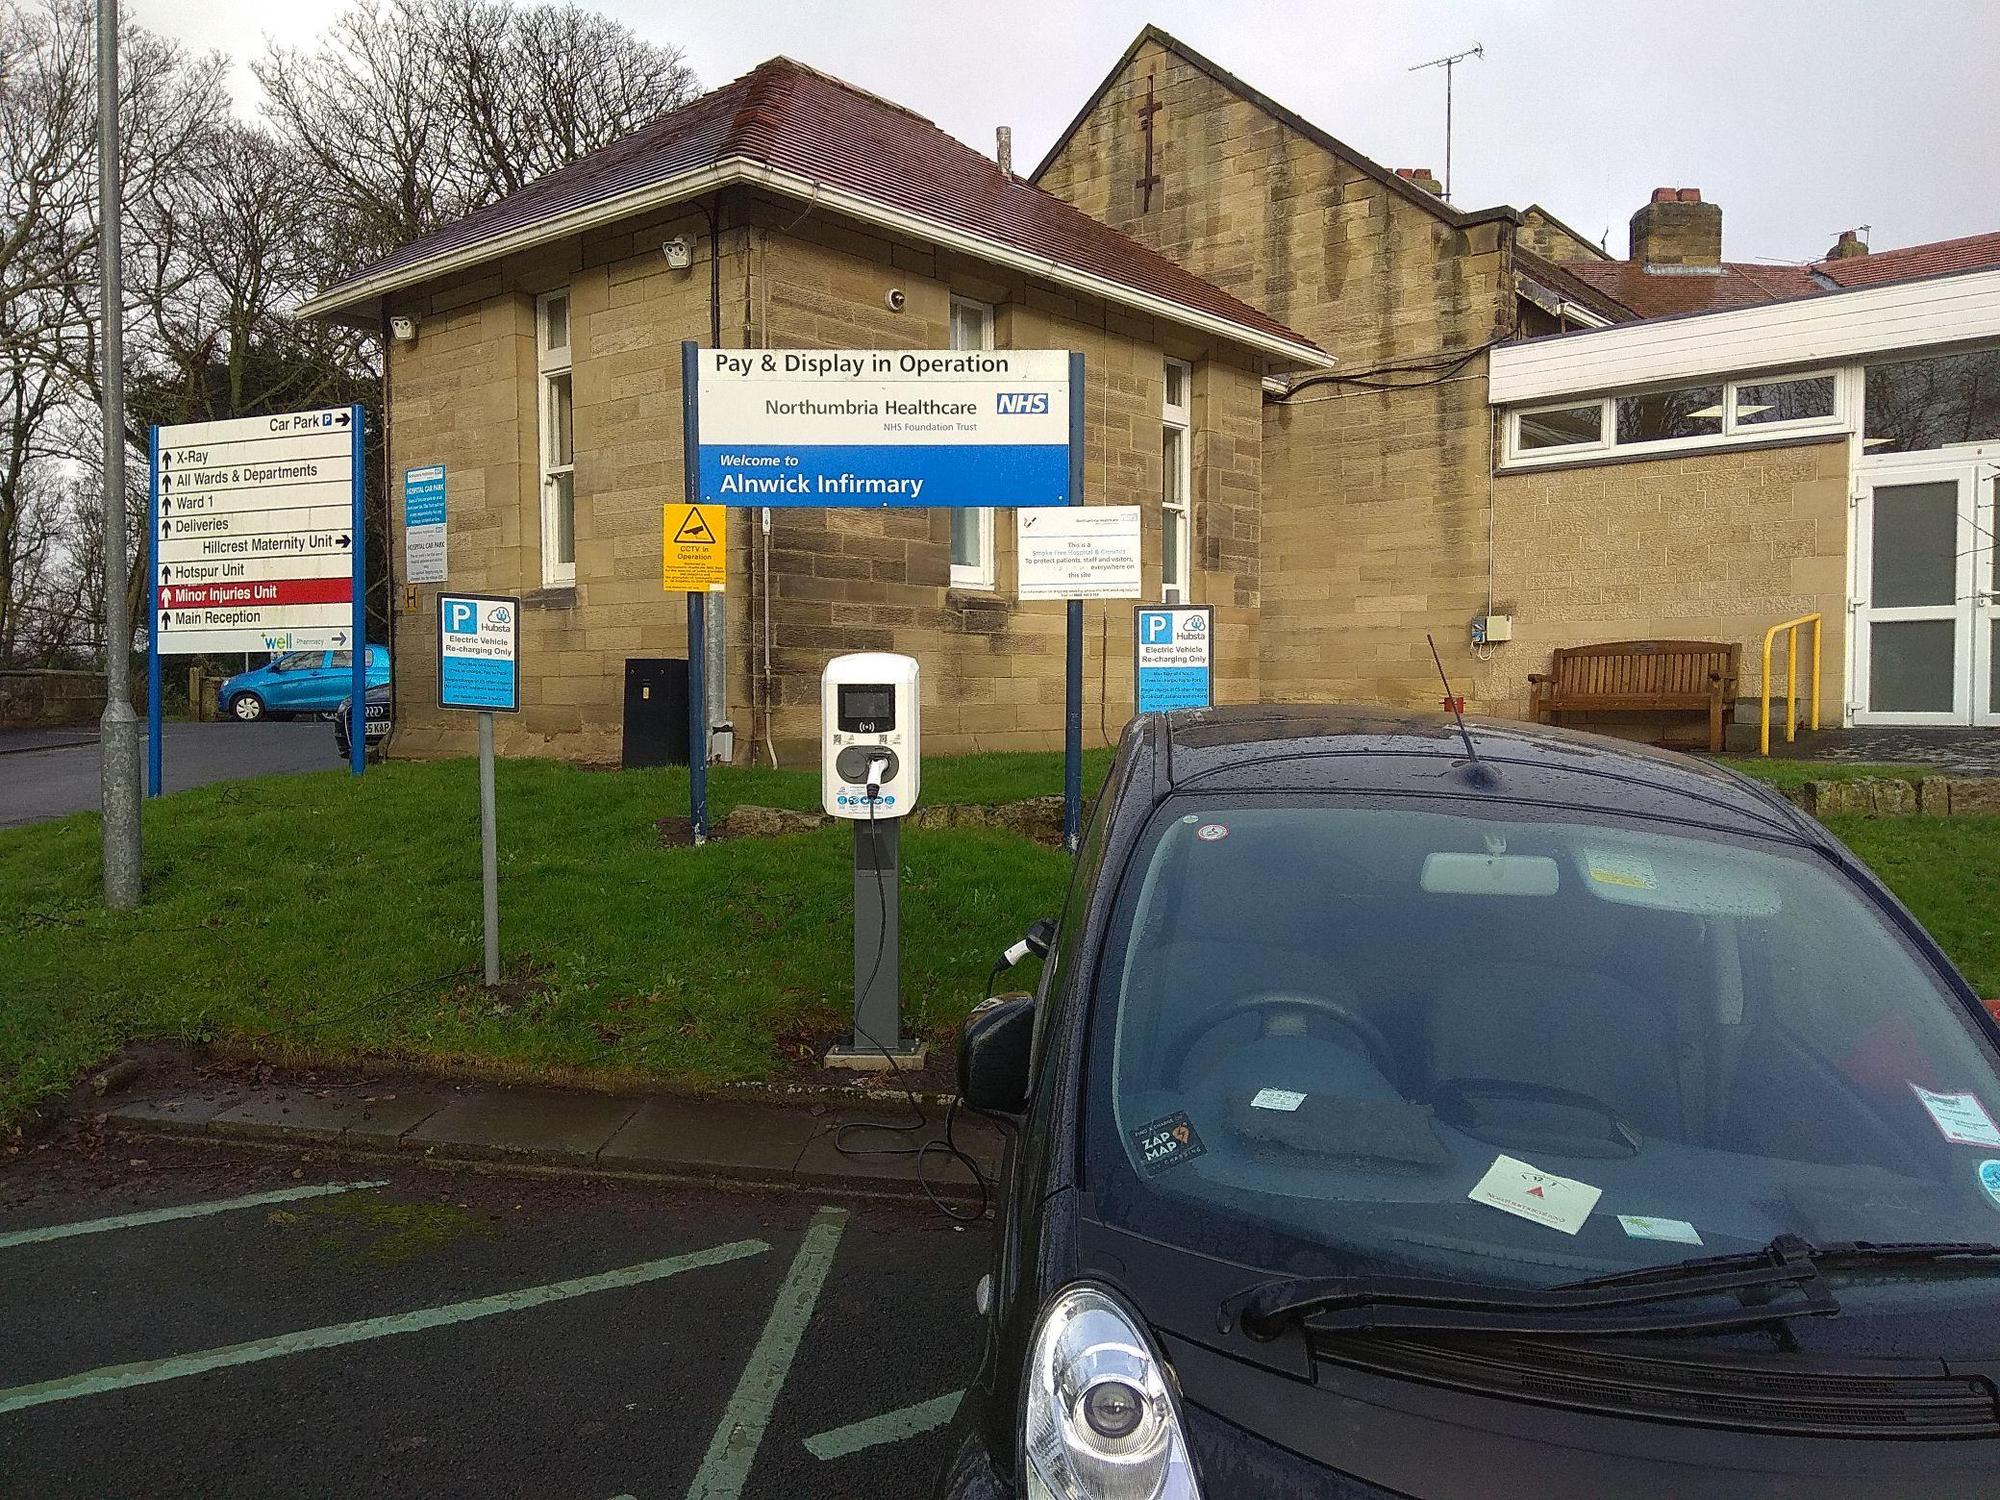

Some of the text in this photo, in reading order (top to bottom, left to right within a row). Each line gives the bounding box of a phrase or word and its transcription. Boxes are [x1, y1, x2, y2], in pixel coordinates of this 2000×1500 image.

[715, 353, 1009, 377] Pay & Display in Operation
[765, 399, 978, 415] Northumbria Healthcare
[997, 393, 1048, 414] NHS
[269, 418, 290, 431] Car
[294, 415, 320, 429] Park
[883, 422, 978, 431] NHS Foundation Trust
[177, 450, 209, 465] X-Ray
[719, 454, 799, 467] Welcome to
[177, 464, 318, 487] All Wards & Departments
[719, 474, 924, 498] Alnwick Infirmary
[176, 495, 213, 510] Ward 1
[176, 517, 229, 533] Deliveries
[203, 535, 333, 554] Hillcrest Maternity Unit
[677, 553, 712, 561] Operation
[175, 563, 245, 580] Hotspur Unit
[175, 585, 278, 604] Minor Injuries Unit
[405, 587, 417, 608] H
[175, 610, 261, 626] Main Reception
[453, 604, 471, 631] P
[481, 623, 511, 633] Hubsta
[1149, 616, 1167, 642] P
[265, 633, 324, 649] well Pharmacy
[449, 635, 508, 646] Electric Vehicle
[1176, 632, 1206, 641] Hubsta
[445, 645, 512, 657] Re-charging Only
[1189, 655, 1207, 663] Only
[1142, 1131, 1170, 1150] ZAP
[1145, 1141, 1177, 1161] MAP
